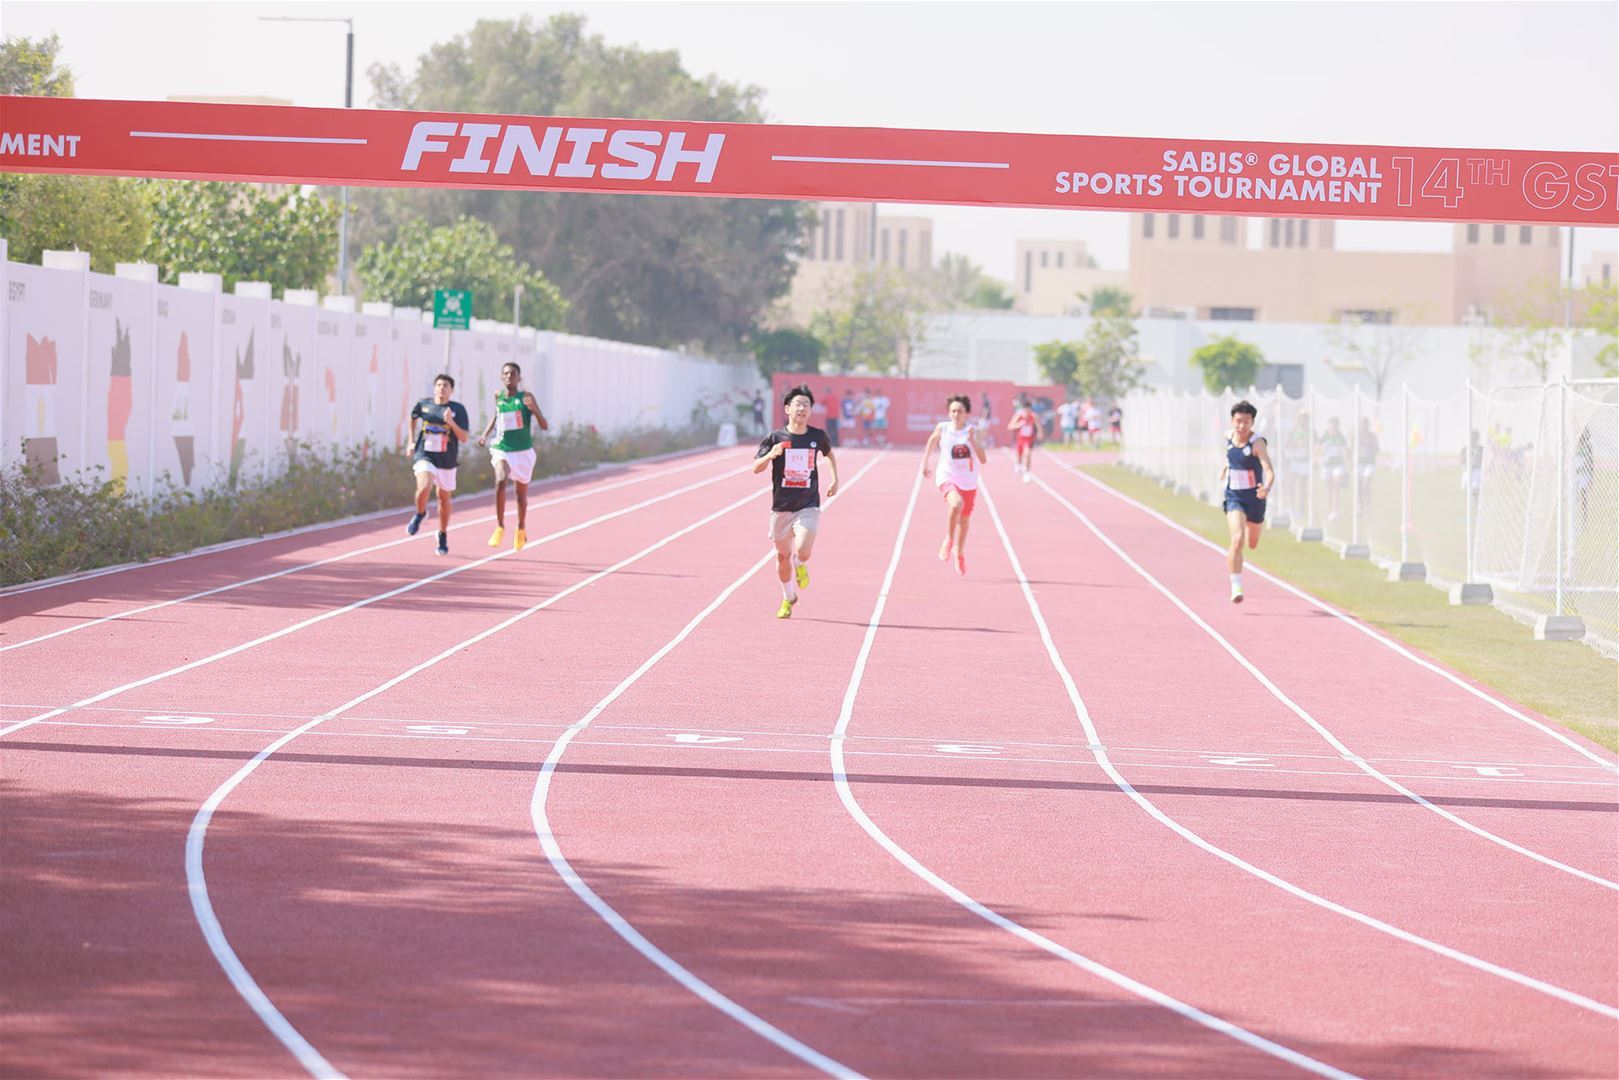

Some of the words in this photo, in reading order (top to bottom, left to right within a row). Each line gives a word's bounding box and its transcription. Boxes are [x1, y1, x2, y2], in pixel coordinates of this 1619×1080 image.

[0, 132, 81, 157] MENT
[401, 121, 726, 183] FINISH
[1268, 154, 1382, 179] GLOBAL
[1055, 171, 1162, 196] SPORTS
[1174, 175, 1382, 203] TOURNAMENT
